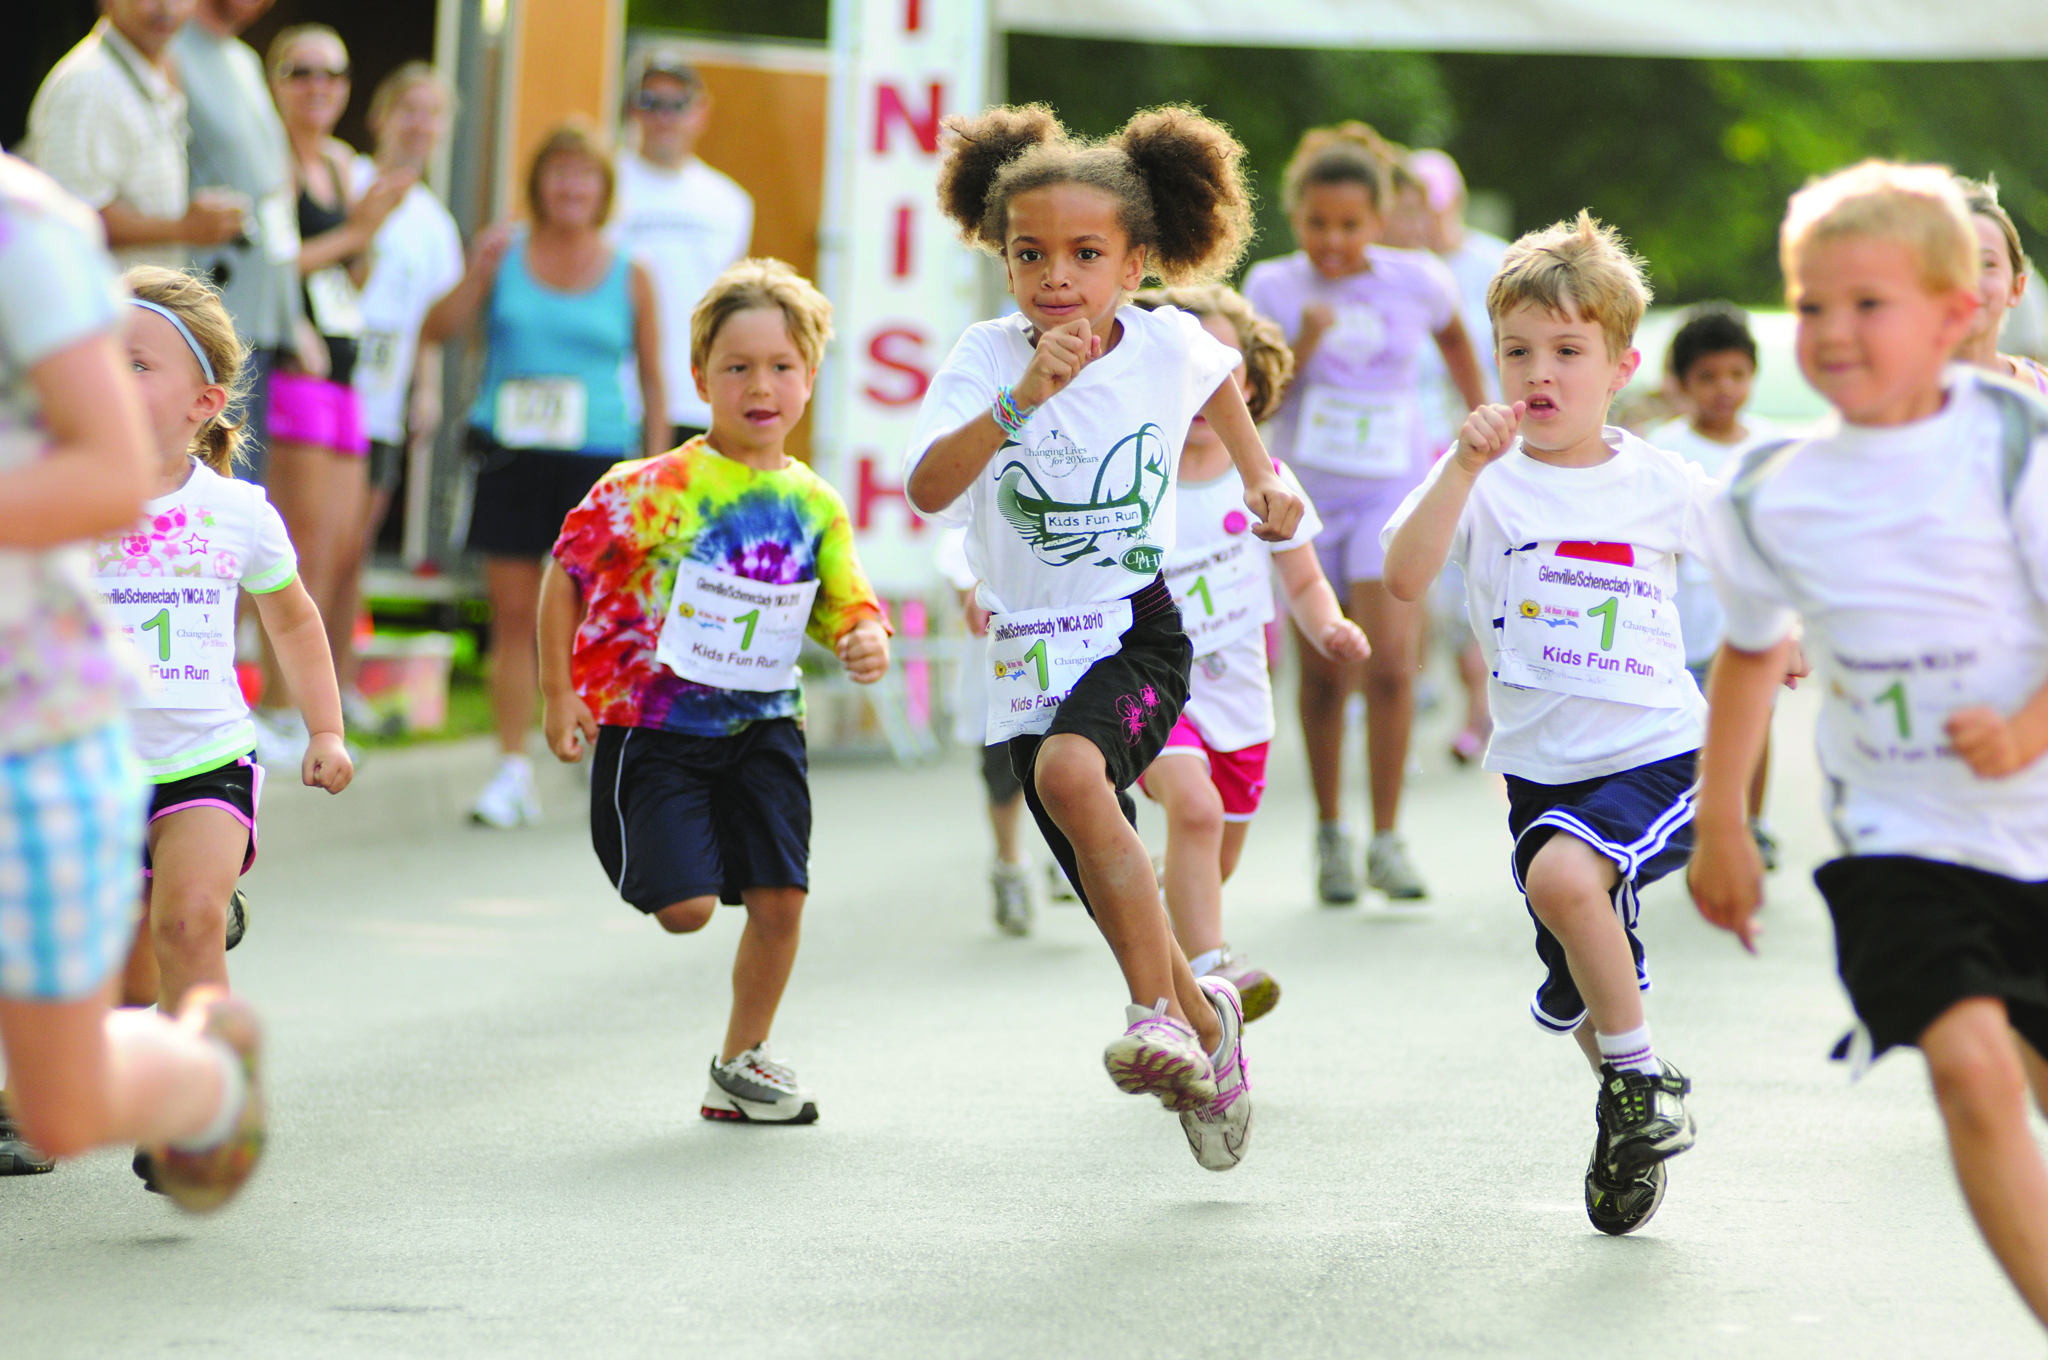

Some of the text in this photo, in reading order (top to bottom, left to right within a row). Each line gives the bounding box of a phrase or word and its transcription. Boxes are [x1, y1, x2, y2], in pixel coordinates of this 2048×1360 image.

[1024, 446, 1088, 459] Changing Lives
[1050, 455, 1099, 468] for 20 Years
[1085, 514, 1111, 526] Fun
[1115, 510, 1139, 521] Run
[1186, 575, 1215, 617] 1
[1538, 565, 1632, 599] Glenville/Schenectady
[1632, 578, 1653, 600] YMCA
[91, 587, 179, 608] lenville/Schenectady
[181, 587, 205, 605] YMCA
[141, 608, 171, 662] 1
[733, 608, 760, 652] 1
[1056, 615, 1083, 634] YMCA
[1083, 612, 1103, 631] 2010
[1587, 596, 1619, 651] 1
[692, 642, 724, 663] Kids
[728, 652, 753, 668] Fun
[756, 655, 779, 669] Run
[1023, 638, 1049, 691] 1
[1054, 653, 1096, 667] Changing
[1543, 645, 1655, 678] Kids Fun Run
[149, 664, 209, 681] Fun Run
[1010, 695, 1033, 713] Kids
[1035, 694, 1061, 710] Fun
[1873, 680, 1911, 739] 1
